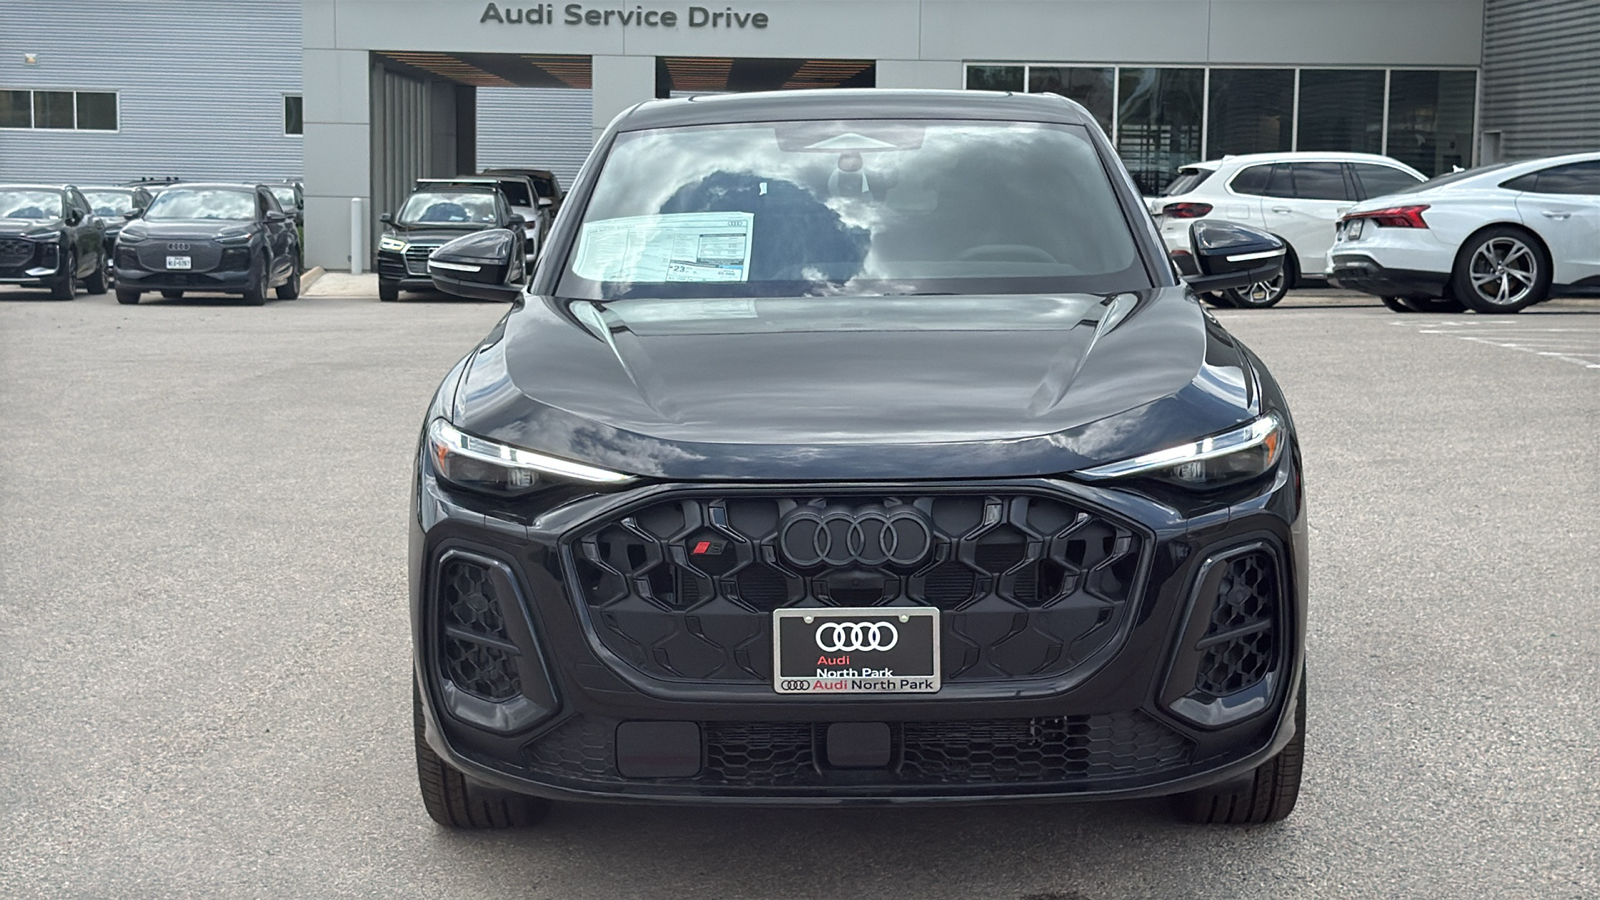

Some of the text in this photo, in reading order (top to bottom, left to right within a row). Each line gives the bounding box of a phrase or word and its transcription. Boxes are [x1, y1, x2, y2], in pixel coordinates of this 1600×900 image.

[480, 2, 769, 29] Audi Service Drive
[817, 655, 850, 665] Audi
[816, 667, 893, 678] North Park
[813, 679, 934, 690] Audi North Park
